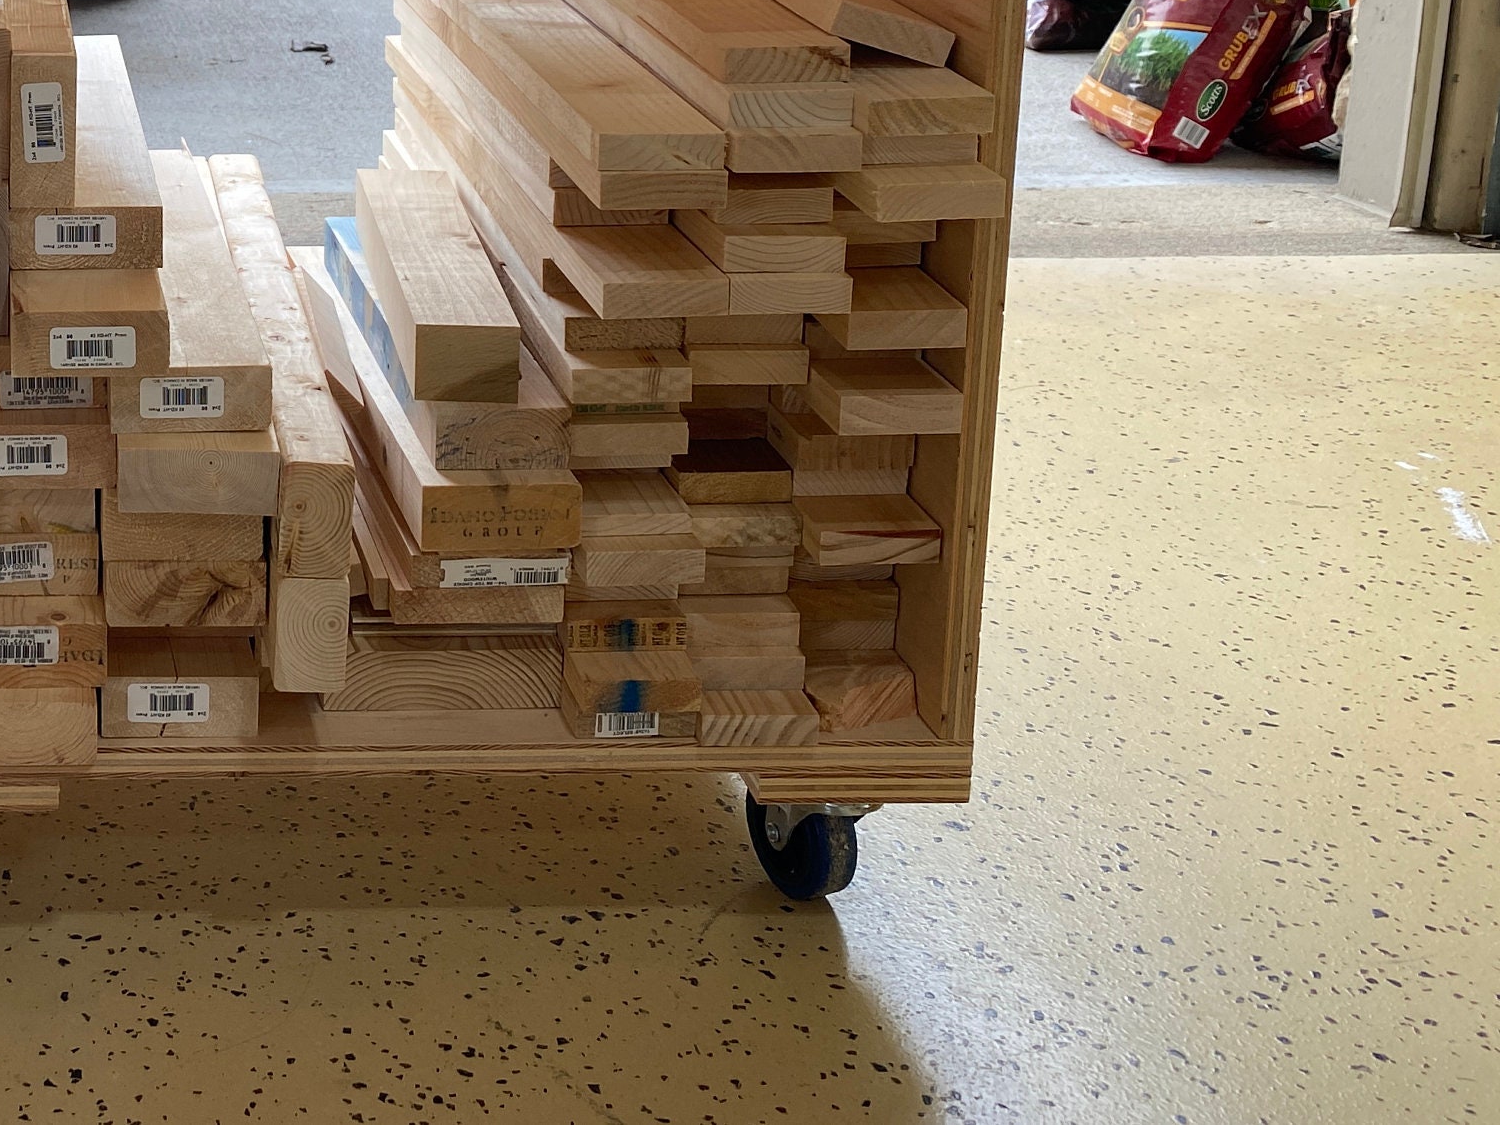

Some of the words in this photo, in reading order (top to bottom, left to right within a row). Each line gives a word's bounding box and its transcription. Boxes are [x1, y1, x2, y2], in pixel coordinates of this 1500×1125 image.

[1200, 84, 1223, 116] Scotts
[430, 506, 496, 524] IDAHO
[58, 650, 105, 666] IDAH
